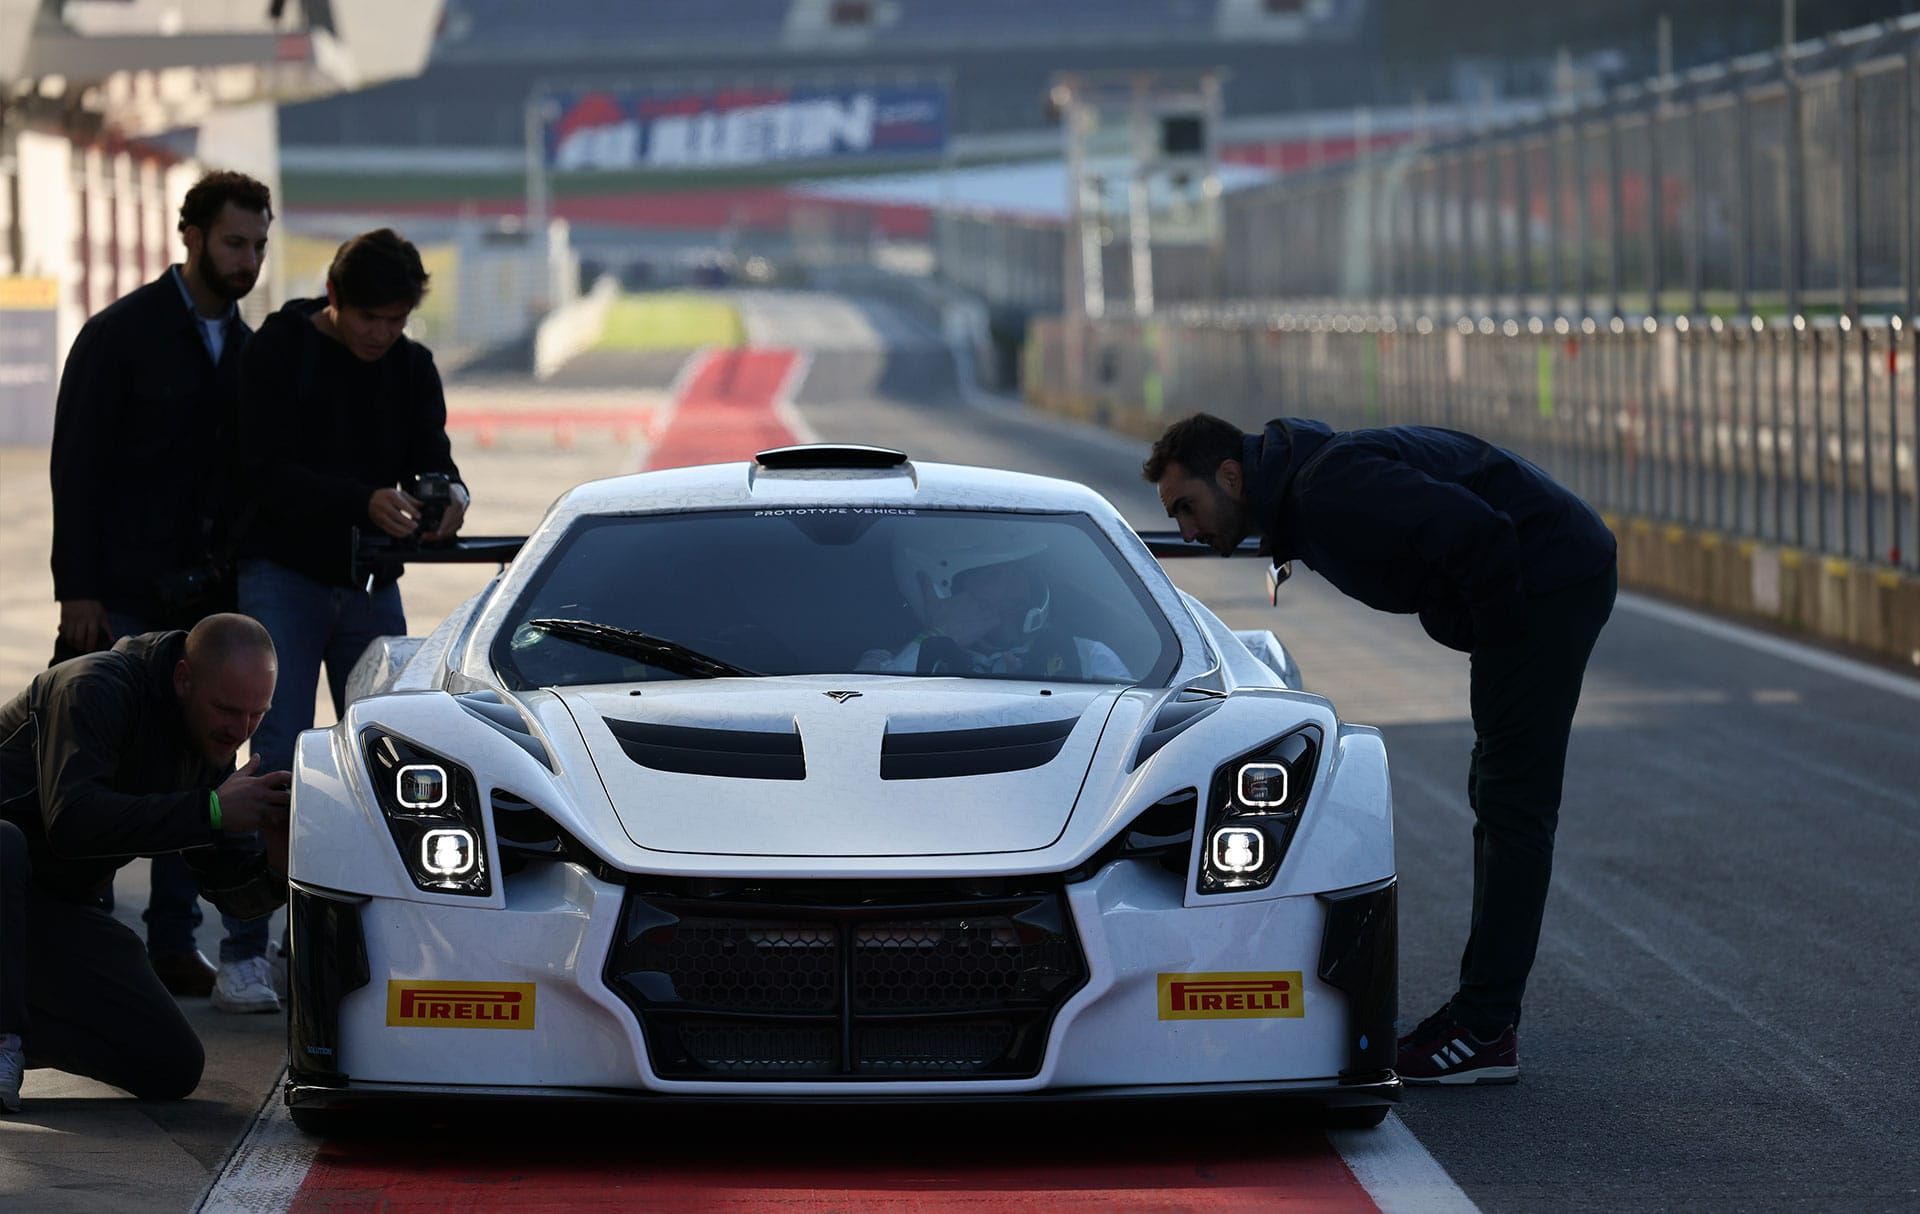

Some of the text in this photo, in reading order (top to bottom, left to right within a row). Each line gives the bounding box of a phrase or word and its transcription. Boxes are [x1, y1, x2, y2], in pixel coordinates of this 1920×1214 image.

[754, 508, 917, 517] PROTOTYPE VEHICLE
[400, 989, 522, 1021] PIRELLI
[1170, 980, 1291, 1012] PIRELLI
